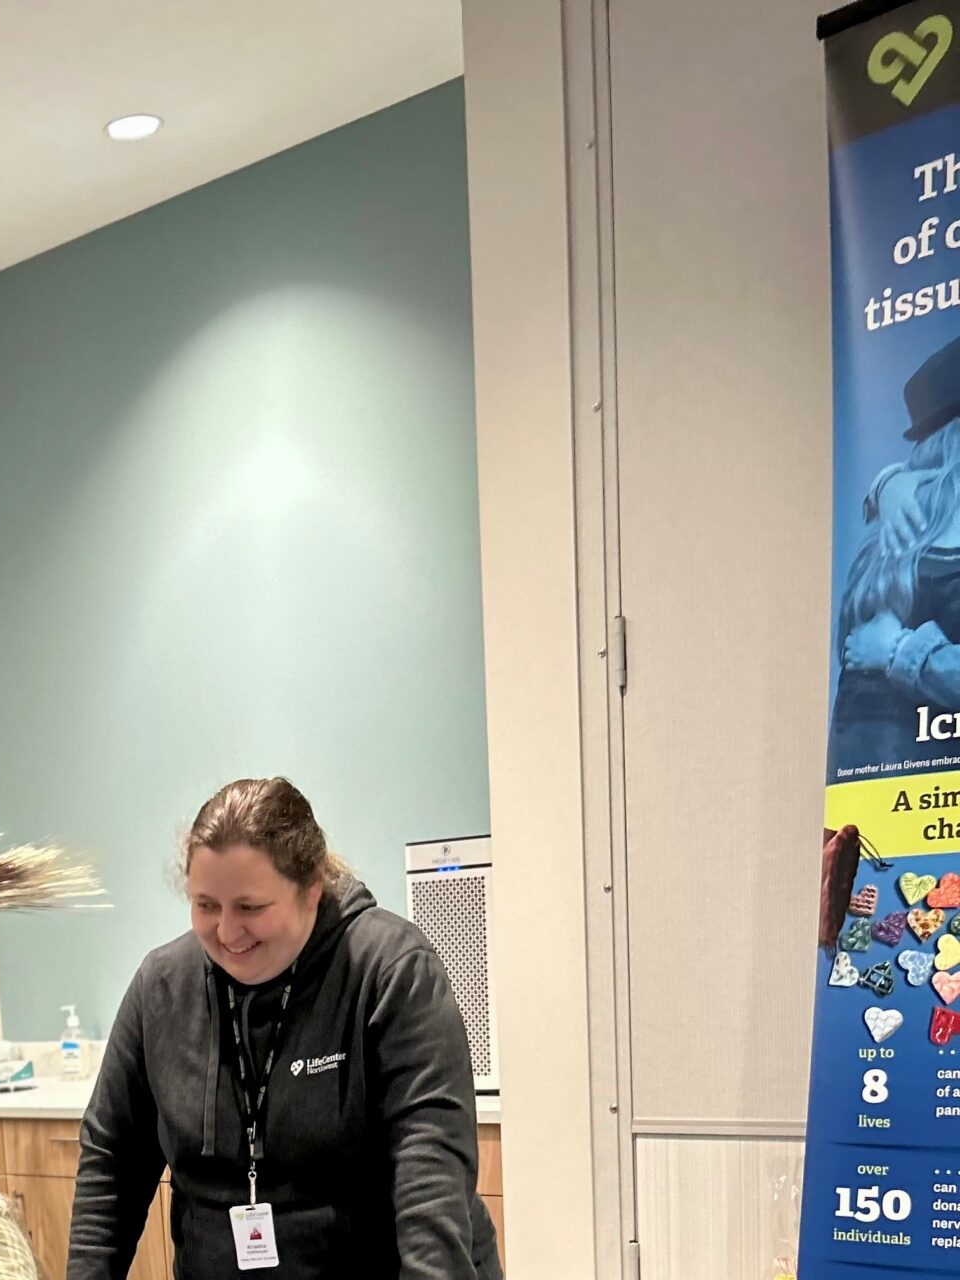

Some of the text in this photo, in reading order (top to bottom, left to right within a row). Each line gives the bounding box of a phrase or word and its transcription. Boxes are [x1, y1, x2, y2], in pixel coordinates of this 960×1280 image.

[914, 153, 960, 202] Th
[894, 216, 939, 265] of
[865, 278, 960, 330] tissu
[837, 768, 854, 777] Donor
[855, 764, 879, 775] mother
[881, 762, 902, 772] Laura
[904, 759, 930, 769] Givens
[892, 786, 960, 812] A sim
[858, 1048, 894, 1061] up to
[937, 1069, 960, 1079] can
[862, 1068, 889, 1104] 8
[936, 1085, 950, 1097] of
[935, 1106, 960, 1118] pan
[858, 1115, 890, 1128] lives
[857, 1164, 888, 1175] over
[933, 1183, 957, 1193] can
[834, 1185, 912, 1223] 150
[833, 1228, 911, 1246] individuals
